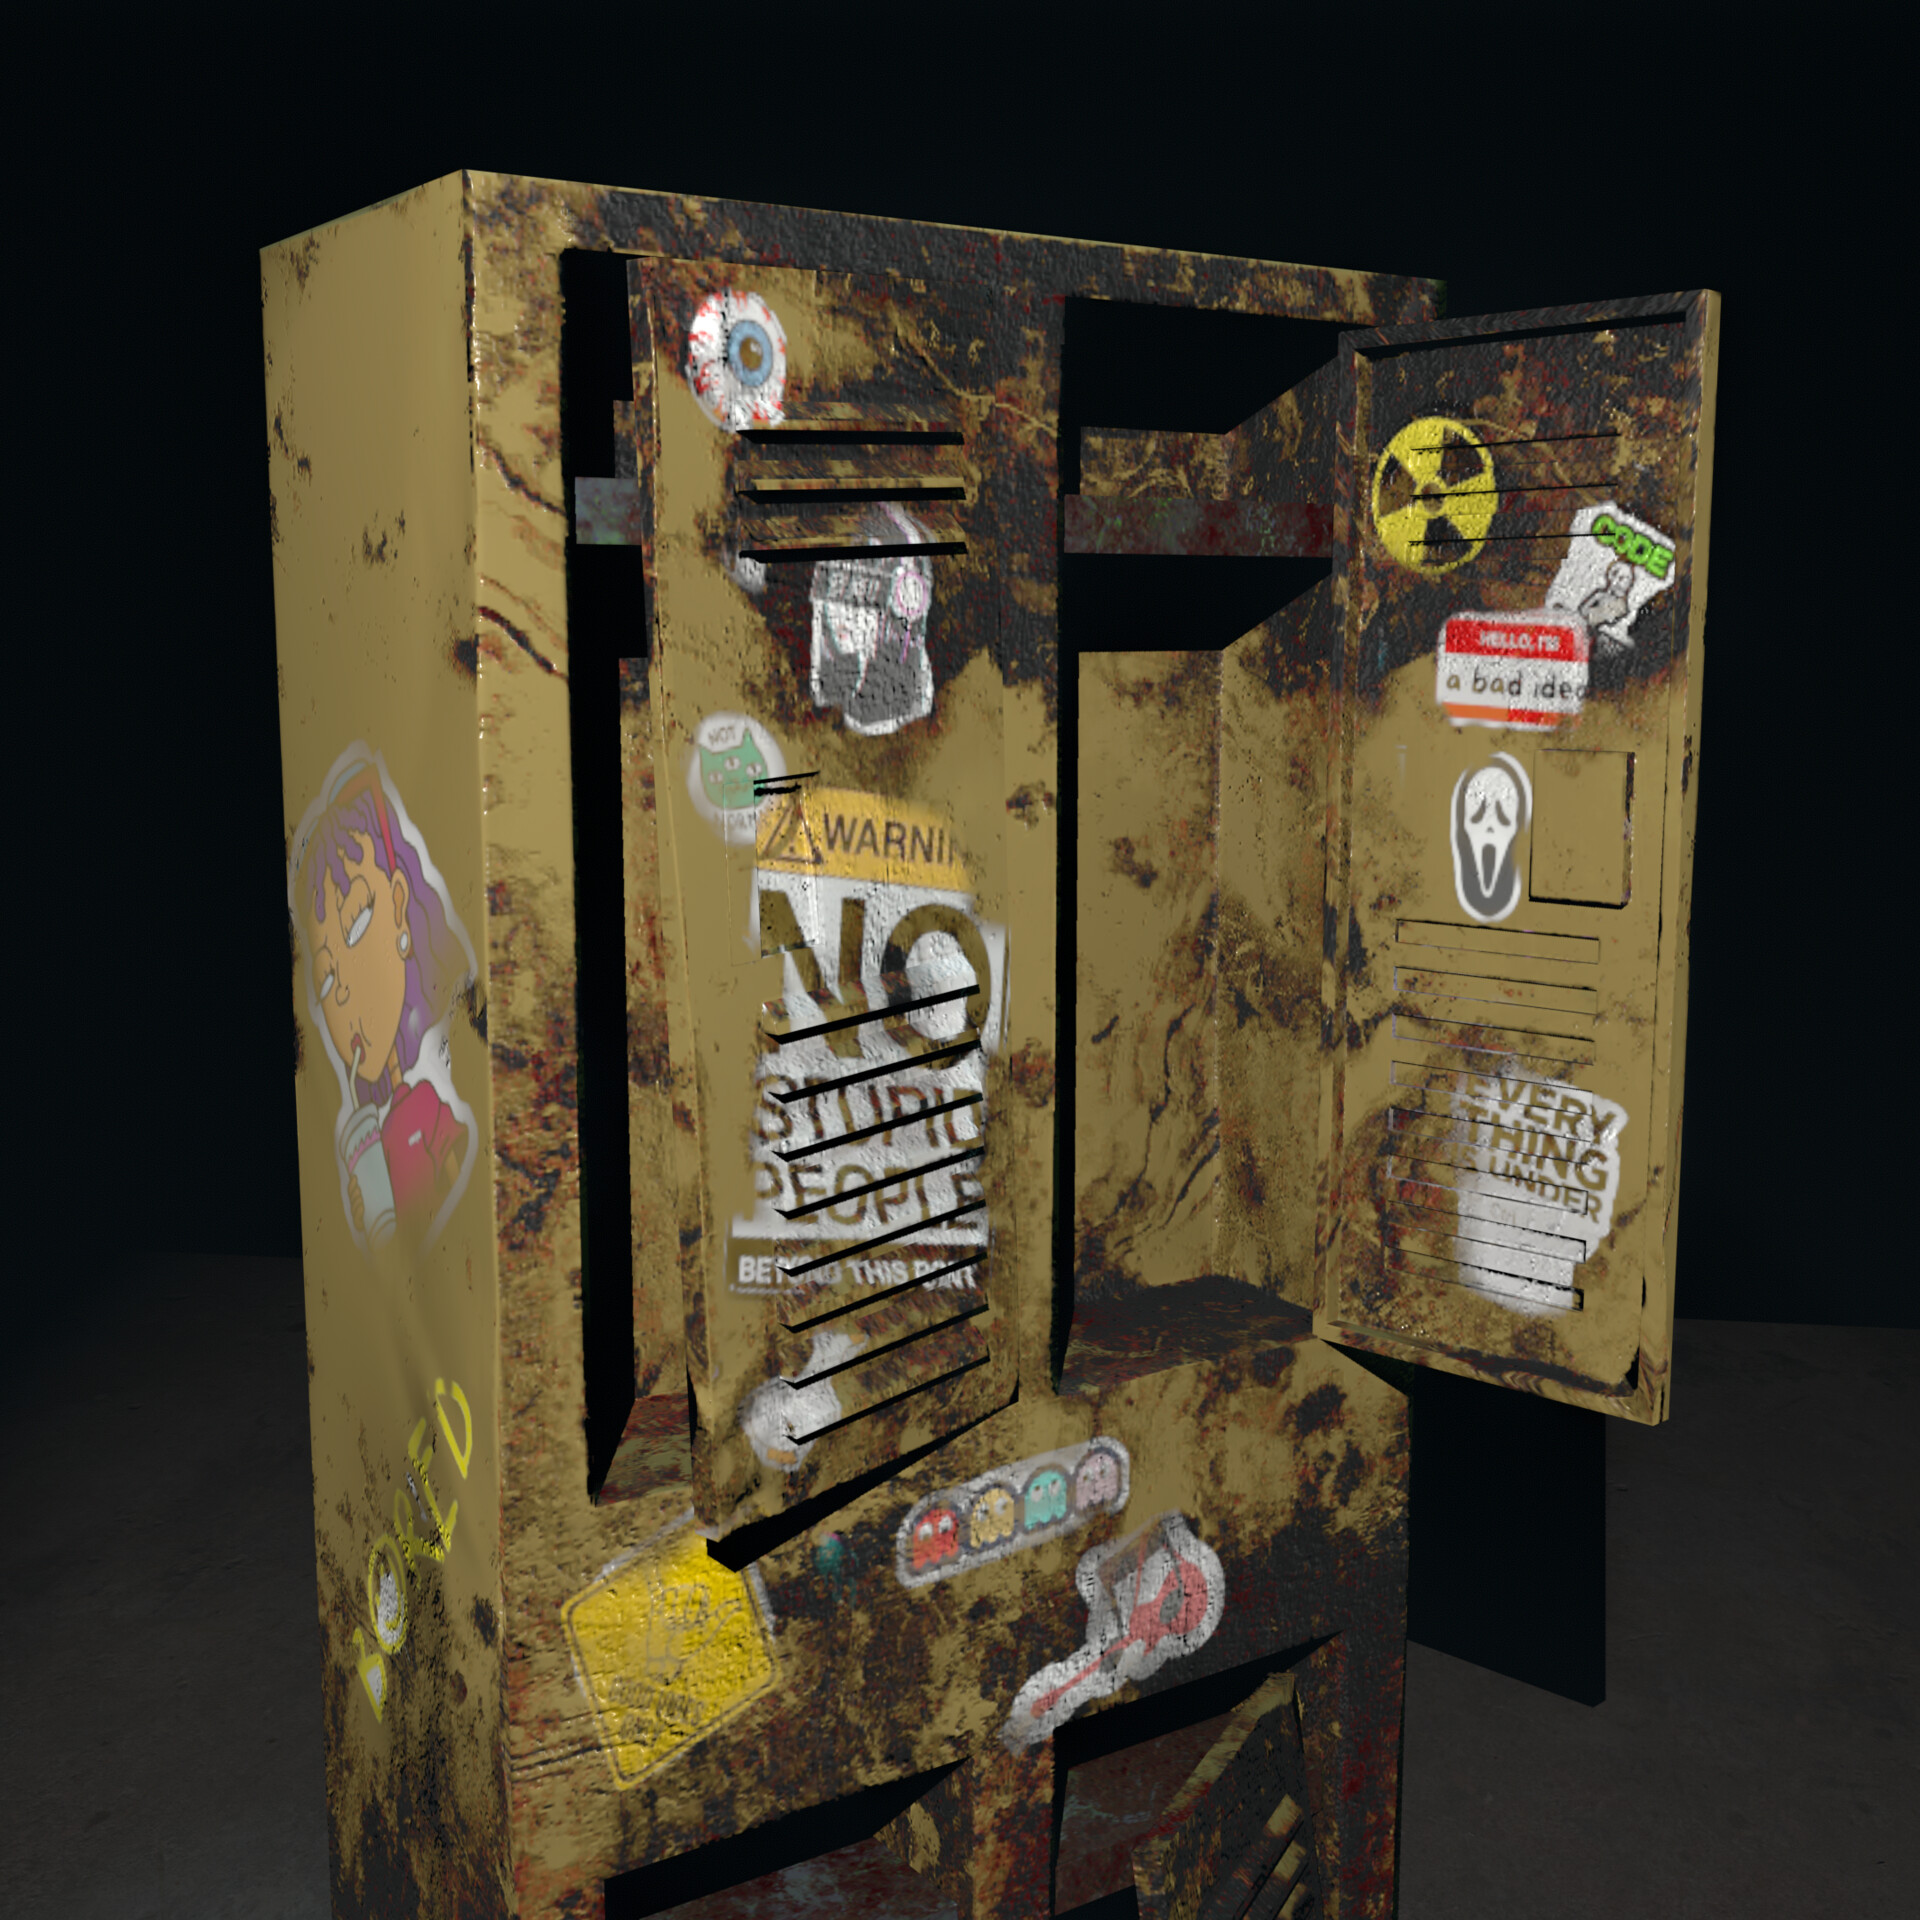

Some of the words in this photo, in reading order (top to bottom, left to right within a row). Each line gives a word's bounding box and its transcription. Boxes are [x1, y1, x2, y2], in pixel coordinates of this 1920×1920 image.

[1591, 514, 1675, 579] CODE
[1446, 674, 1461, 691] a
[1472, 666, 1523, 697] bad
[708, 726, 737, 746] NOT
[757, 889, 992, 1070] NO
[754, 1074, 981, 1148] STUPID
[1459, 1096, 1609, 1191] THING
[1465, 1074, 1617, 1144] EVERY
[1488, 1155, 1603, 1224] UNDER
[846, 1259, 910, 1286] THIS
